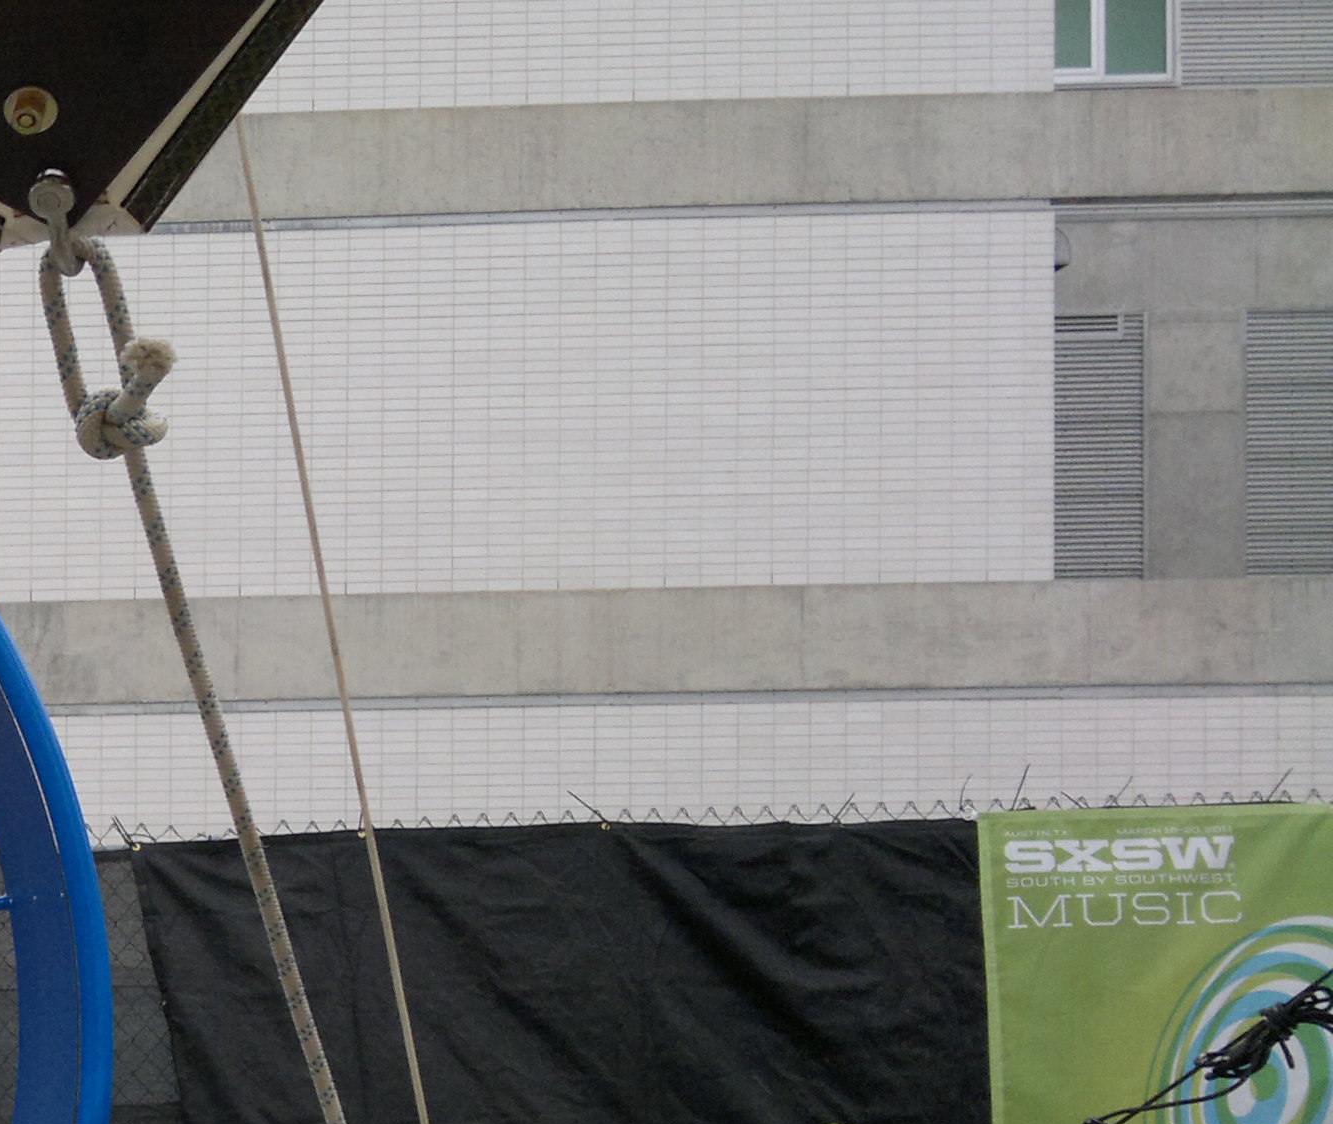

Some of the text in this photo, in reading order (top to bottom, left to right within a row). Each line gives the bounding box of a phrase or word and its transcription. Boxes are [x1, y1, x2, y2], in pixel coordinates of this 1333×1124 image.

[1004, 835, 1235, 874] SXSW
[1006, 872, 1234, 888] SOUTH BY SOUTHWEST
[1006, 890, 1243, 929] MUSIC
